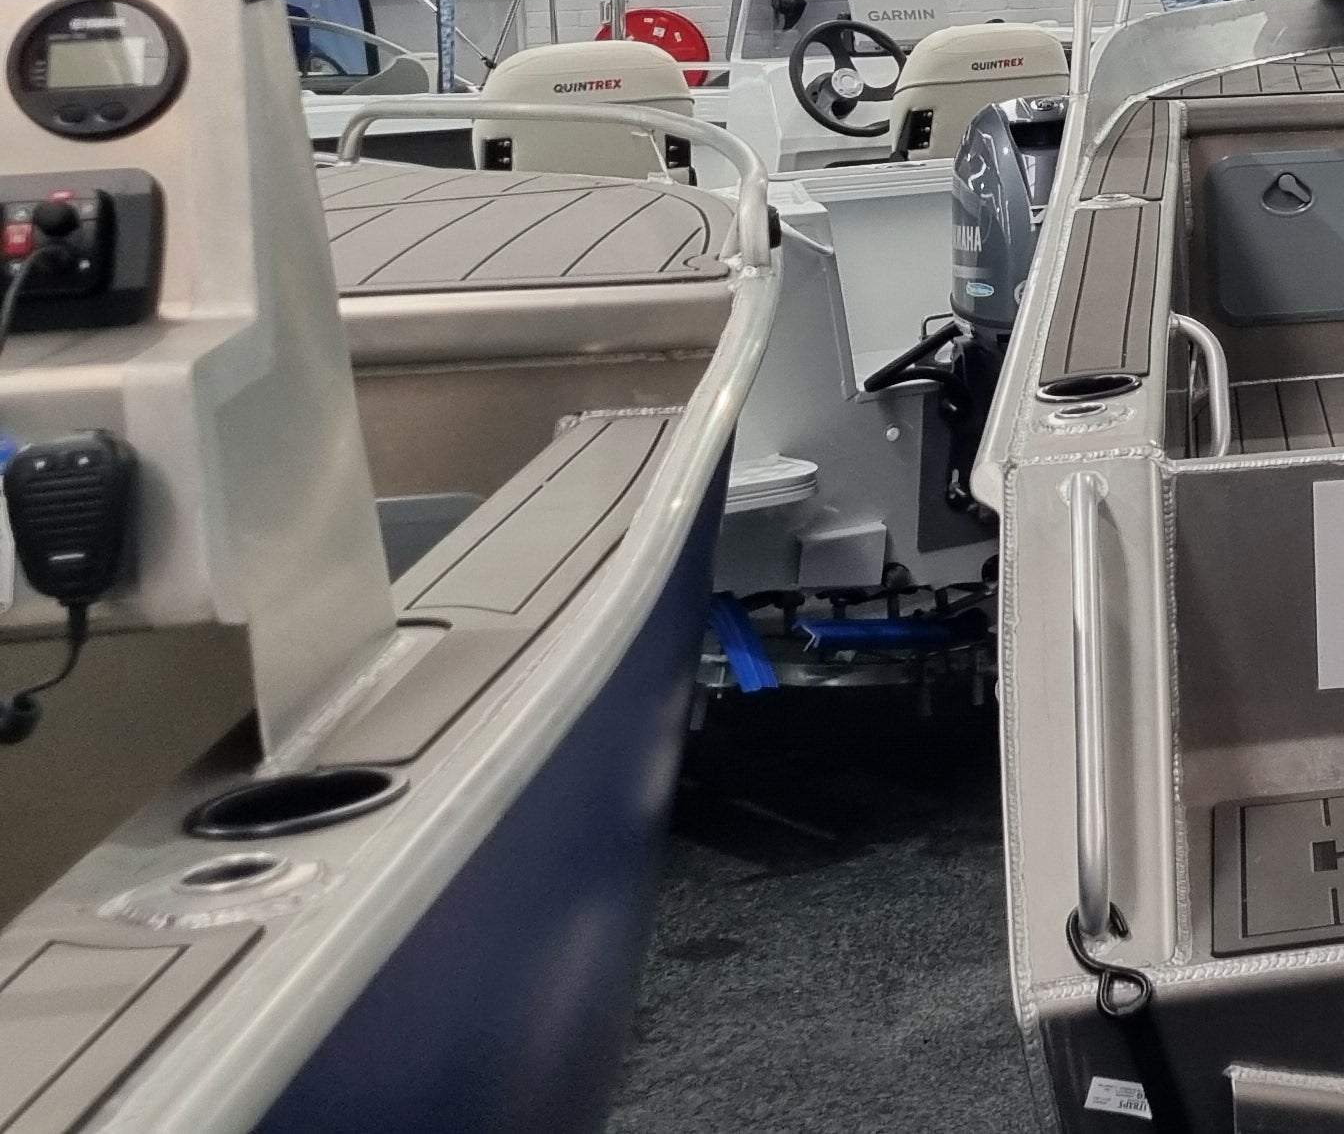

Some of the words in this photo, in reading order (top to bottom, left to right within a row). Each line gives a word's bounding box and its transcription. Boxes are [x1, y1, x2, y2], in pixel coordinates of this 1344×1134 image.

[868, 8, 935, 22] GARMIN
[971, 57, 1024, 71] QUINTREX
[553, 78, 622, 94] QUINTREX
